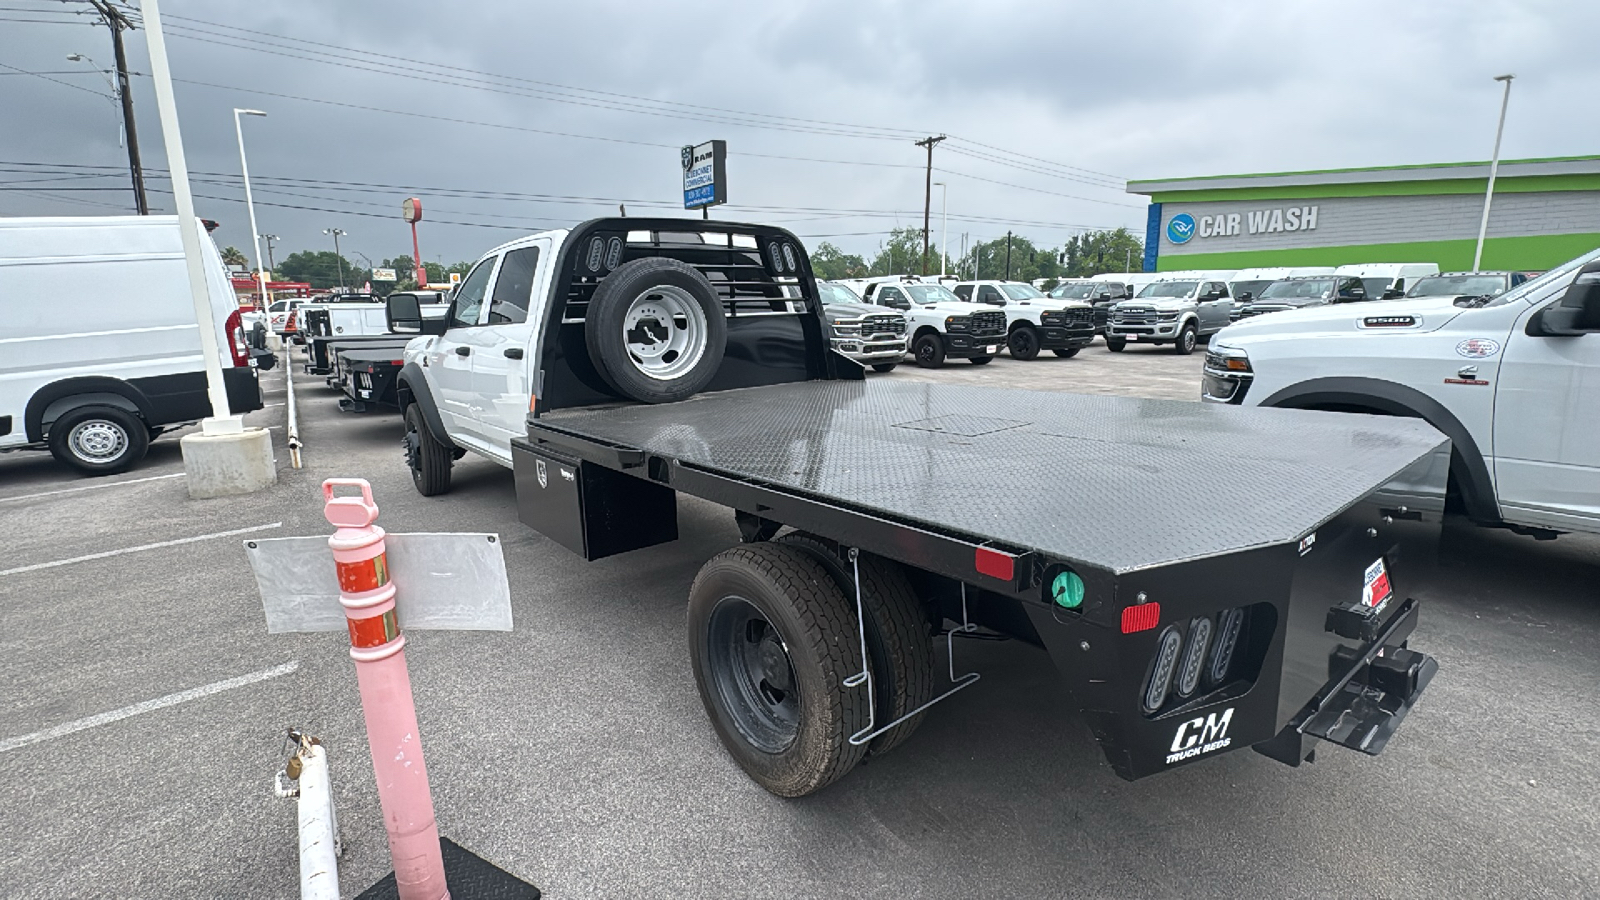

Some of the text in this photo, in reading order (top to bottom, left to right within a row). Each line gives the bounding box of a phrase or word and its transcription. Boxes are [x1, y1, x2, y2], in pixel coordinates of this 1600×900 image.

[694, 151, 712, 163] RAM
[1200, 206, 1319, 238] CAR WASH
[1170, 707, 1235, 752] CM
[1166, 737, 1231, 764] TRUCK BEDS
